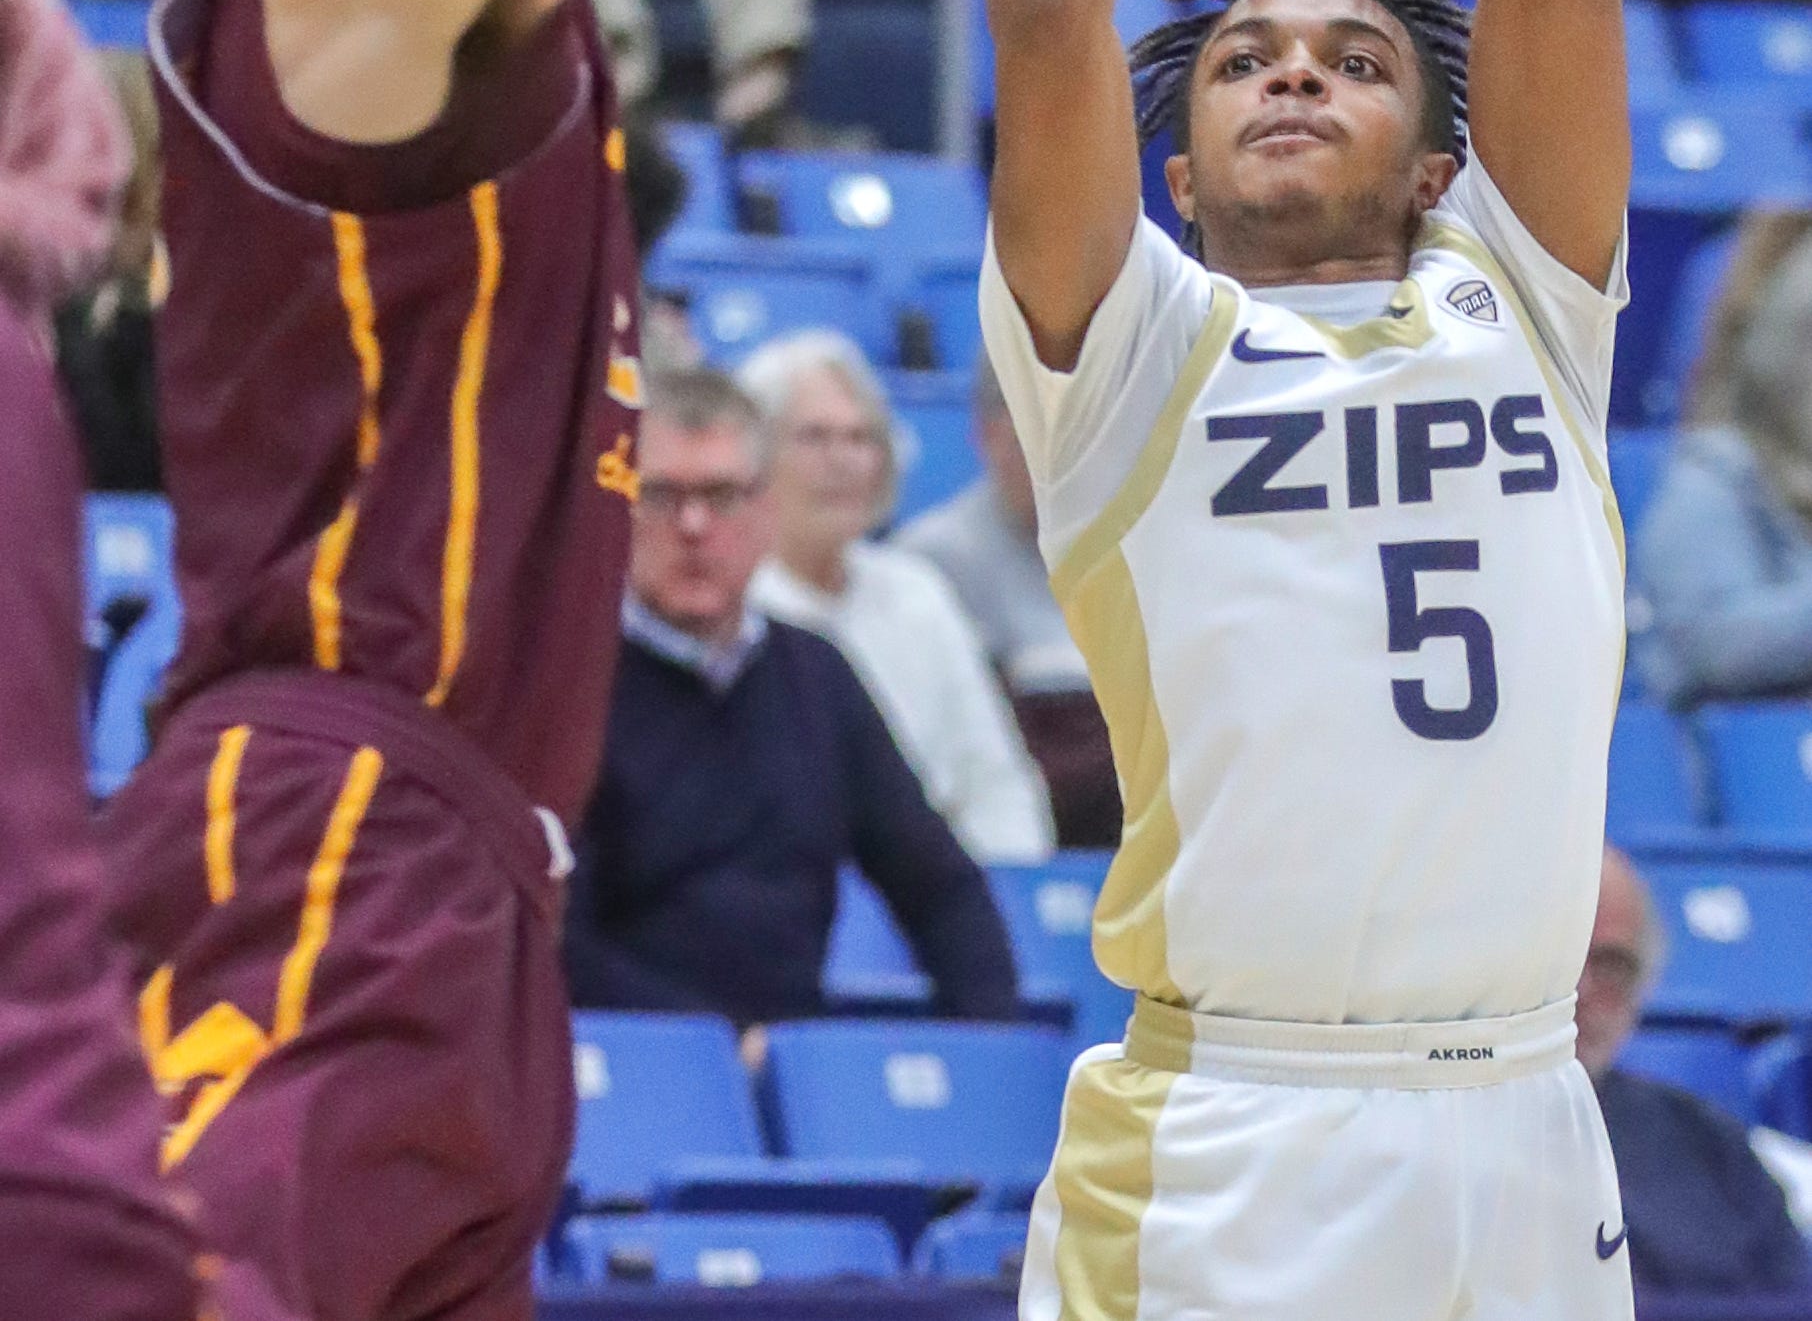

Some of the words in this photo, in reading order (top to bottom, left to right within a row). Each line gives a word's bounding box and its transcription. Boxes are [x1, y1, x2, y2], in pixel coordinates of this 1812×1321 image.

[1206, 394, 1559, 517] ZIPS
[1378, 539, 1498, 741] 5
[1428, 1047, 1494, 1060] AKRON
